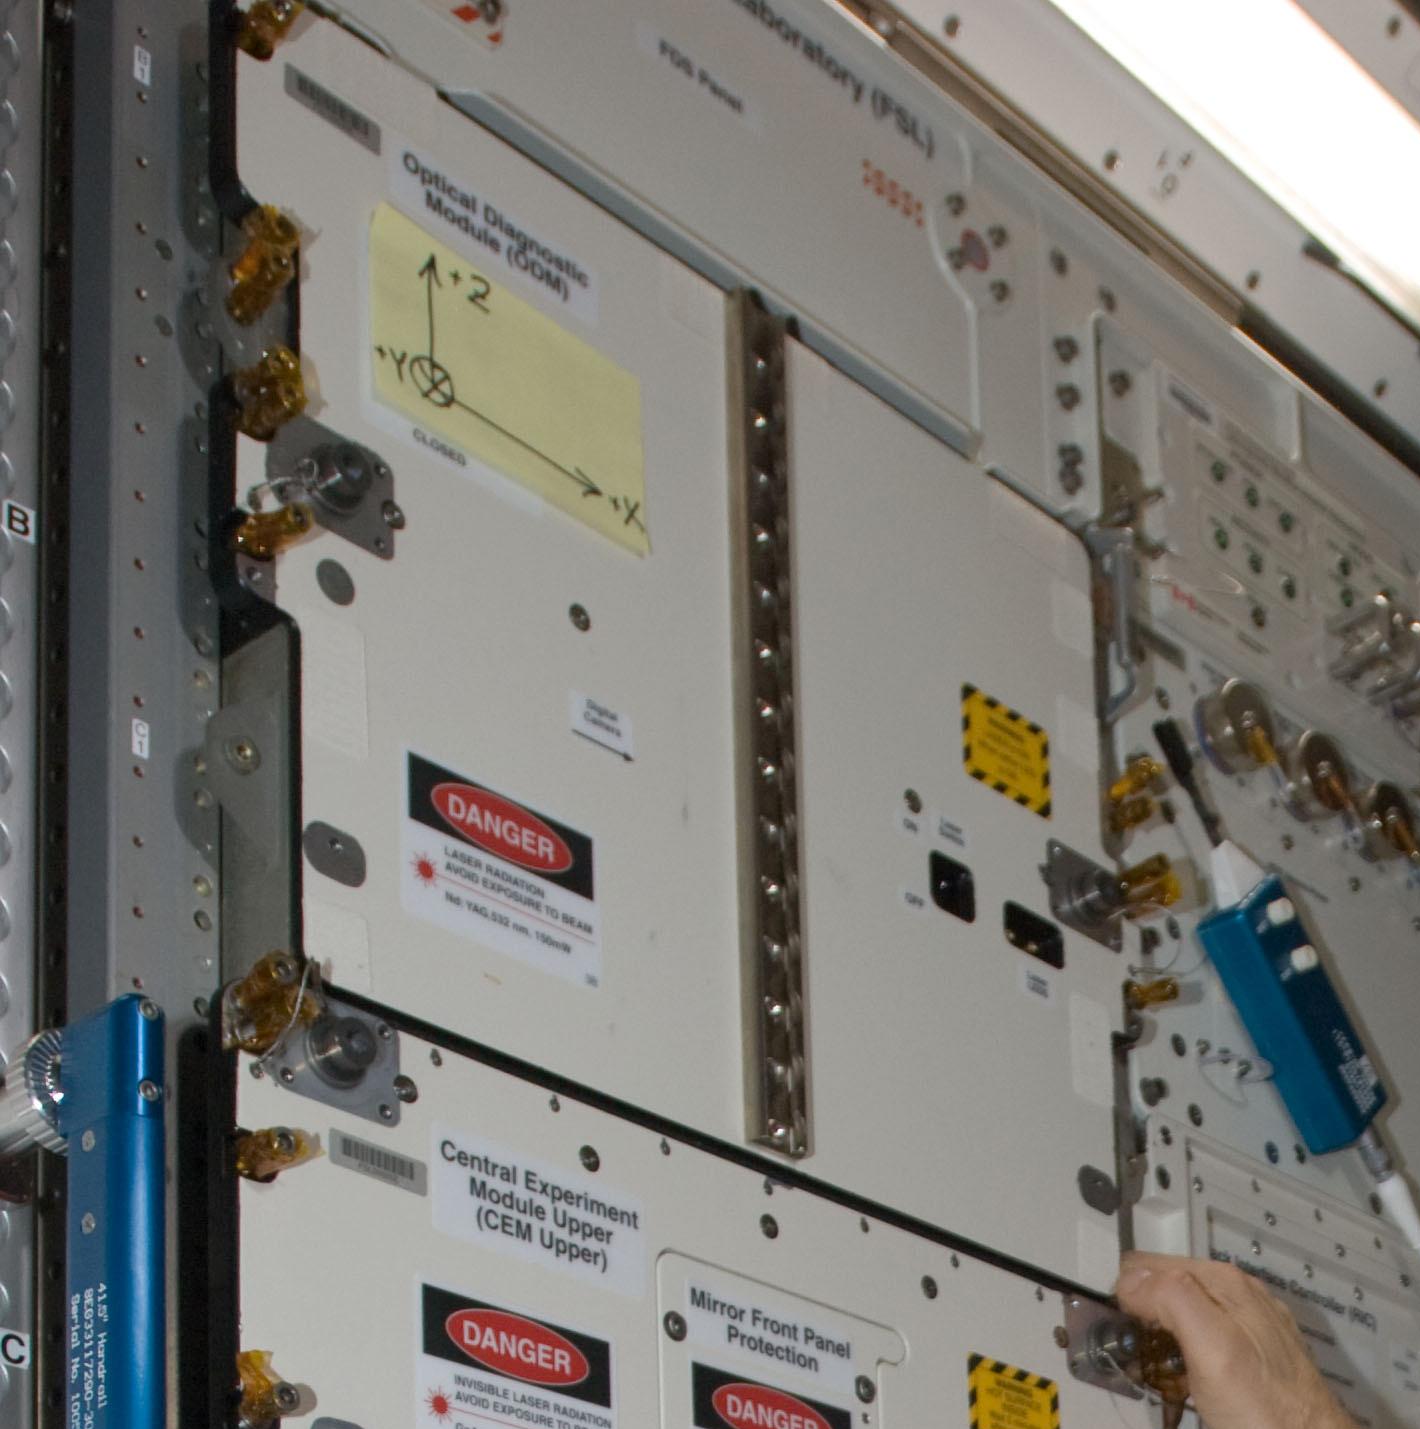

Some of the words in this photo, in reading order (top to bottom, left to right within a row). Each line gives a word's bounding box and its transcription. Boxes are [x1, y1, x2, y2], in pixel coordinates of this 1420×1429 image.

[403, 152, 477, 213] Optical
[483, 203, 589, 288] Diagnostic
[425, 189, 500, 254] Module
[506, 245, 569, 302] (ODM)
[8, 506, 30, 537] B
[447, 793, 555, 863] DANGER
[444, 845, 483, 871] LASER
[485, 863, 545, 900] RADIATION
[445, 862, 479, 885] AVOID
[482, 877, 542, 913] EXPOSURE
[544, 903, 559, 919] TO
[561, 908, 593, 935] BEAM
[440, 1139, 517, 1185] Central
[524, 1169, 640, 1230] Experiment
[469, 1176, 546, 1221] Module
[553, 1205, 614, 1245] Upper
[476, 1205, 533, 1243] (CEM
[540, 1228, 608, 1274] Upper)
[0, 1334, 26, 1365] C
[71, 1293, 80, 1350] Serial
[462, 1319, 571, 1376] DANGER
[691, 1286, 746, 1323] Mirror
[751, 1308, 798, 1343] Front
[804, 1326, 851, 1360] Panel
[727, 1324, 819, 1373] Protection
[71, 1357, 80, 1384] No.
[97, 1332, 109, 1409] Handrail
[454, 1374, 509, 1400] INVISIBLE
[512, 1391, 550, 1411] LASER
[553, 1403, 612, 1429] RADIATION
[455, 1390, 489, 1410] AVOID
[492, 1400, 554, 1428] EXPOSURE
